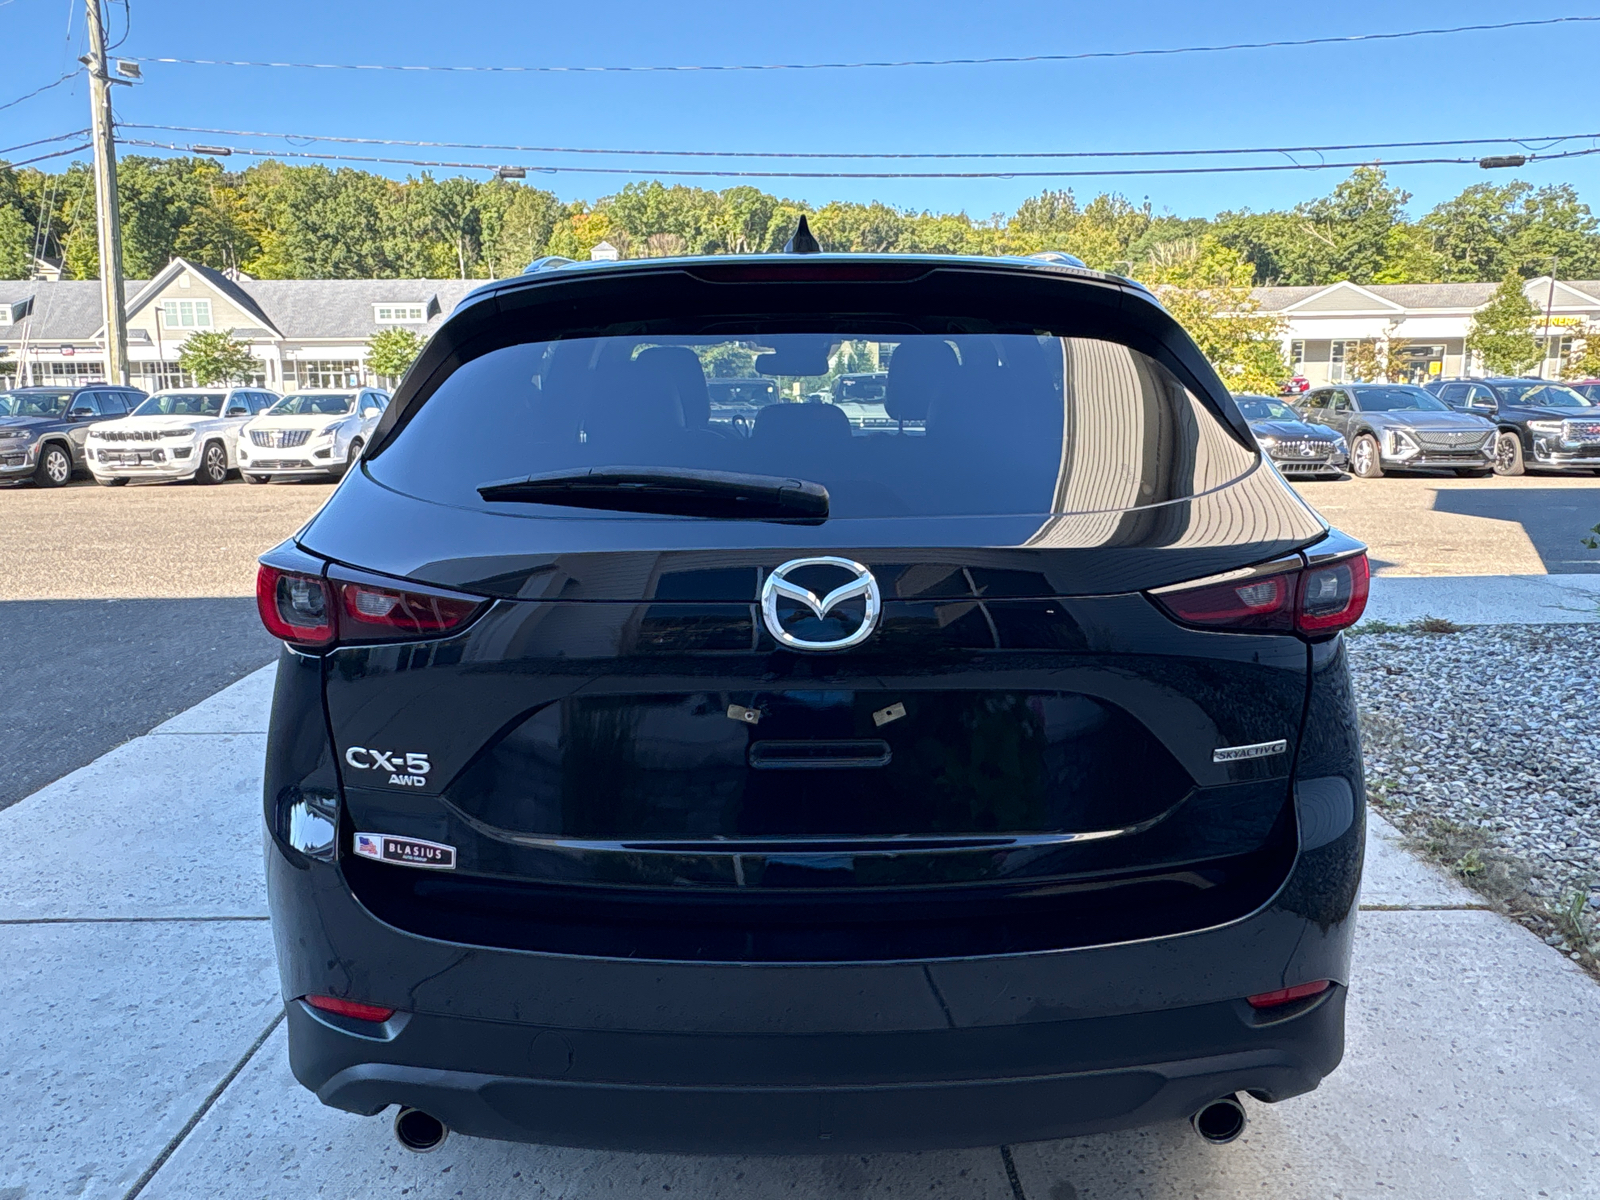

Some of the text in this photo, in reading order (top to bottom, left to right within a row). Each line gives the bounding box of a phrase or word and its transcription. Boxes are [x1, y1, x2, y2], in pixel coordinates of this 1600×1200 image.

[345, 746, 431, 775] CX-5
[388, 774, 427, 787] AWD
[388, 842, 442, 860] BLASIUS
